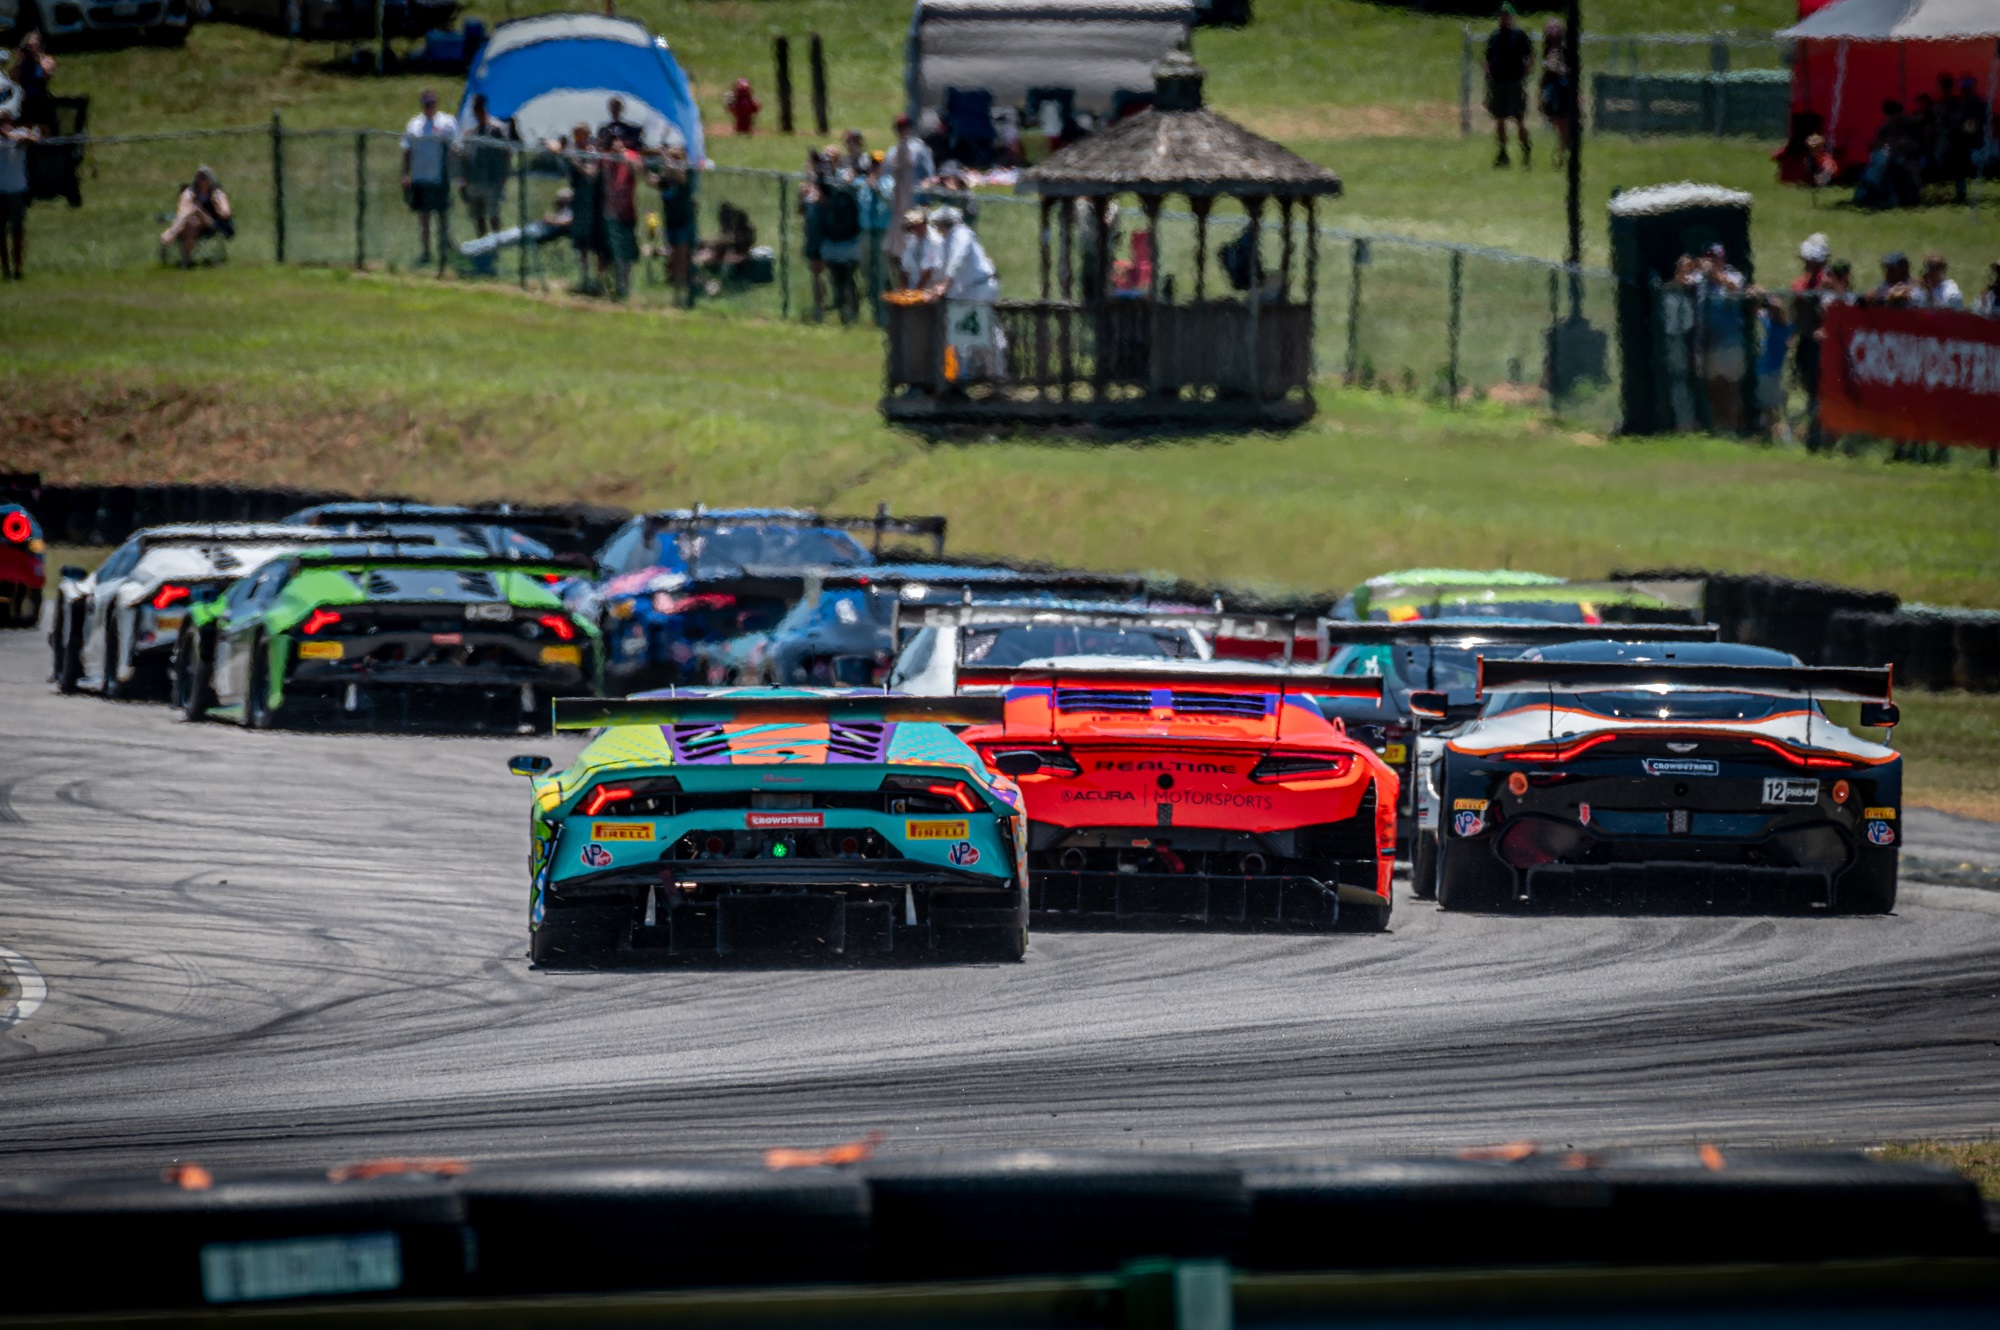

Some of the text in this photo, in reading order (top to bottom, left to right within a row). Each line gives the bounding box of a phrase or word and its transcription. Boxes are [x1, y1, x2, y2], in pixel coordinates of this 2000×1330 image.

[1095, 761, 1236, 773] REALTIME
[1653, 762, 1714, 772] CROWDSTRIKE
[1074, 790, 1273, 810] ACURA MOTORSPORTS
[1766, 782, 1818, 801] 12 PRO-AM
[751, 815, 820, 825] CROWDSTRIKE
[910, 822, 965, 837] PIRELLI
[1456, 811, 1473, 834] VP
[595, 825, 650, 839] PIRELLI
[1869, 821, 1887, 843] VP
[582, 843, 602, 867] VP
[951, 841, 971, 865] VP
